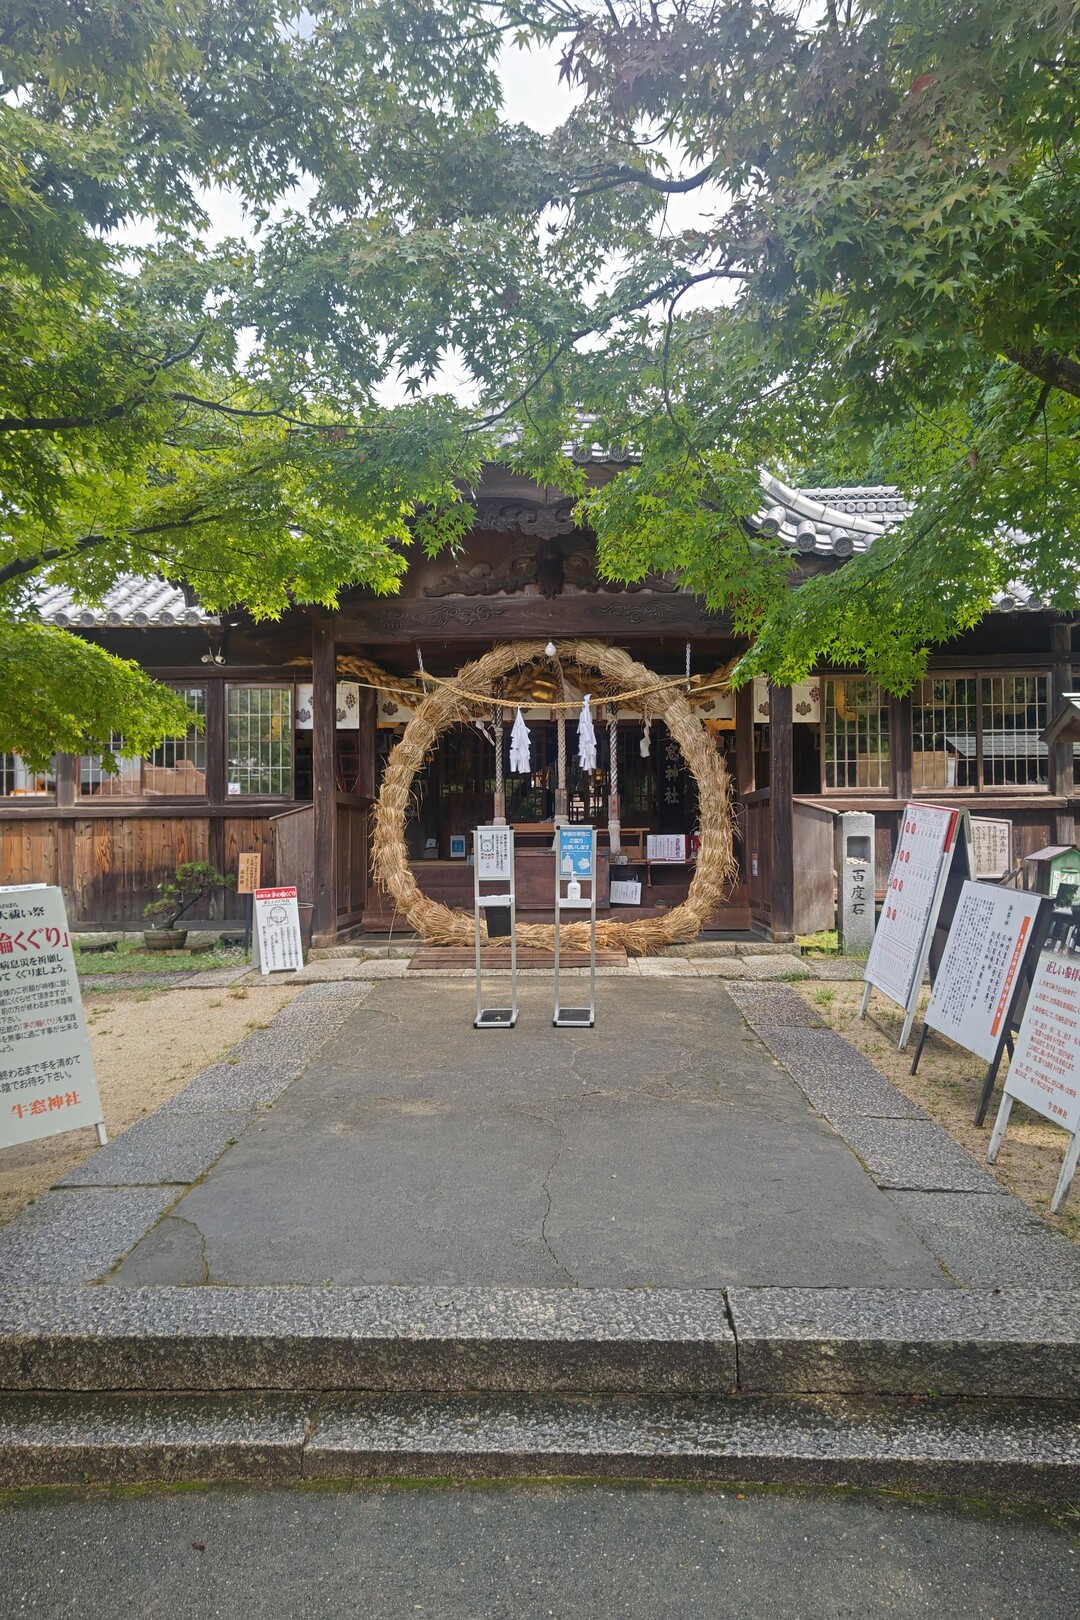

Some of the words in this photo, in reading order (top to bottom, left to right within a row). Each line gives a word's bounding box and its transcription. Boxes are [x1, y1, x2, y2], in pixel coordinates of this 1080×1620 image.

[664, 727, 680, 804] 窓神社
[850, 868, 866, 915] 百度石
[16, 964, 67, 979] くぐりましょう。
[1046, 961, 1080, 982] 正しい参拝
[0, 1015, 21, 1024] 下さい。
[0, 1045, 14, 1053] ょう。
[0, 1071, 72, 1093] 陰でお待ち下さい。
[11, 1091, 82, 1119] 牛窓神社
